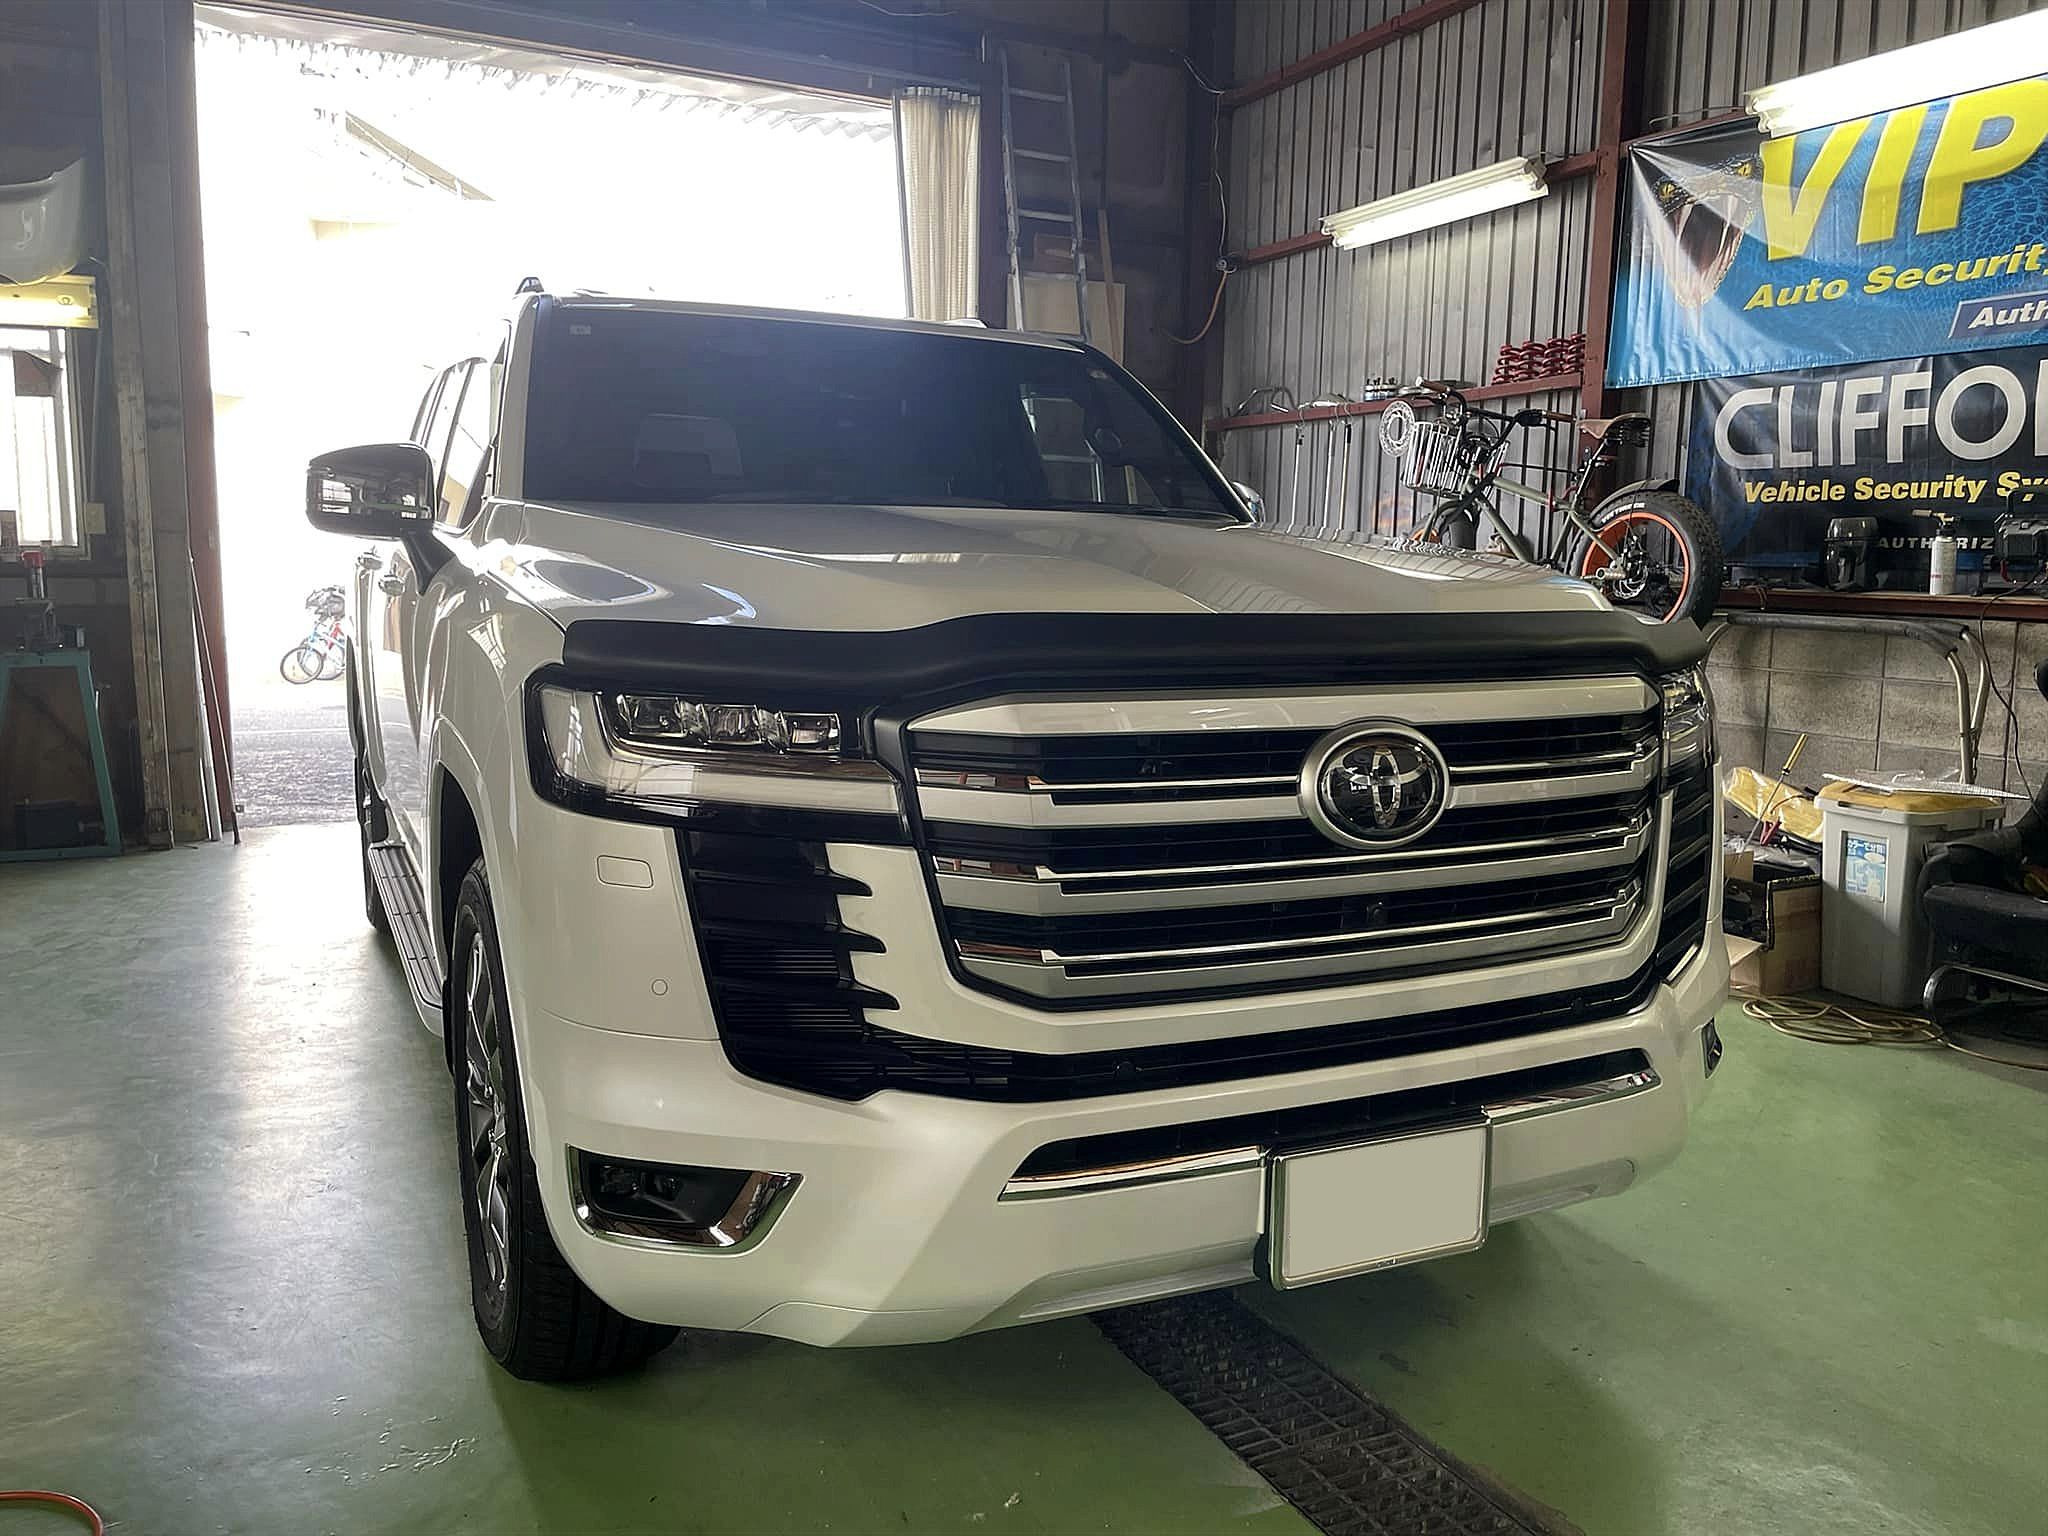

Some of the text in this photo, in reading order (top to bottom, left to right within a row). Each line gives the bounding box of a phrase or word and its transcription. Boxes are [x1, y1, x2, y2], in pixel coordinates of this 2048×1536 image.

[1761, 79, 2048, 261] VIP
[1744, 244, 2048, 311] Auto Securit
[1744, 479, 1846, 503] Vehicle
[1853, 474, 1988, 503] Security
[1879, 537, 1994, 550] AUTHRIZ
